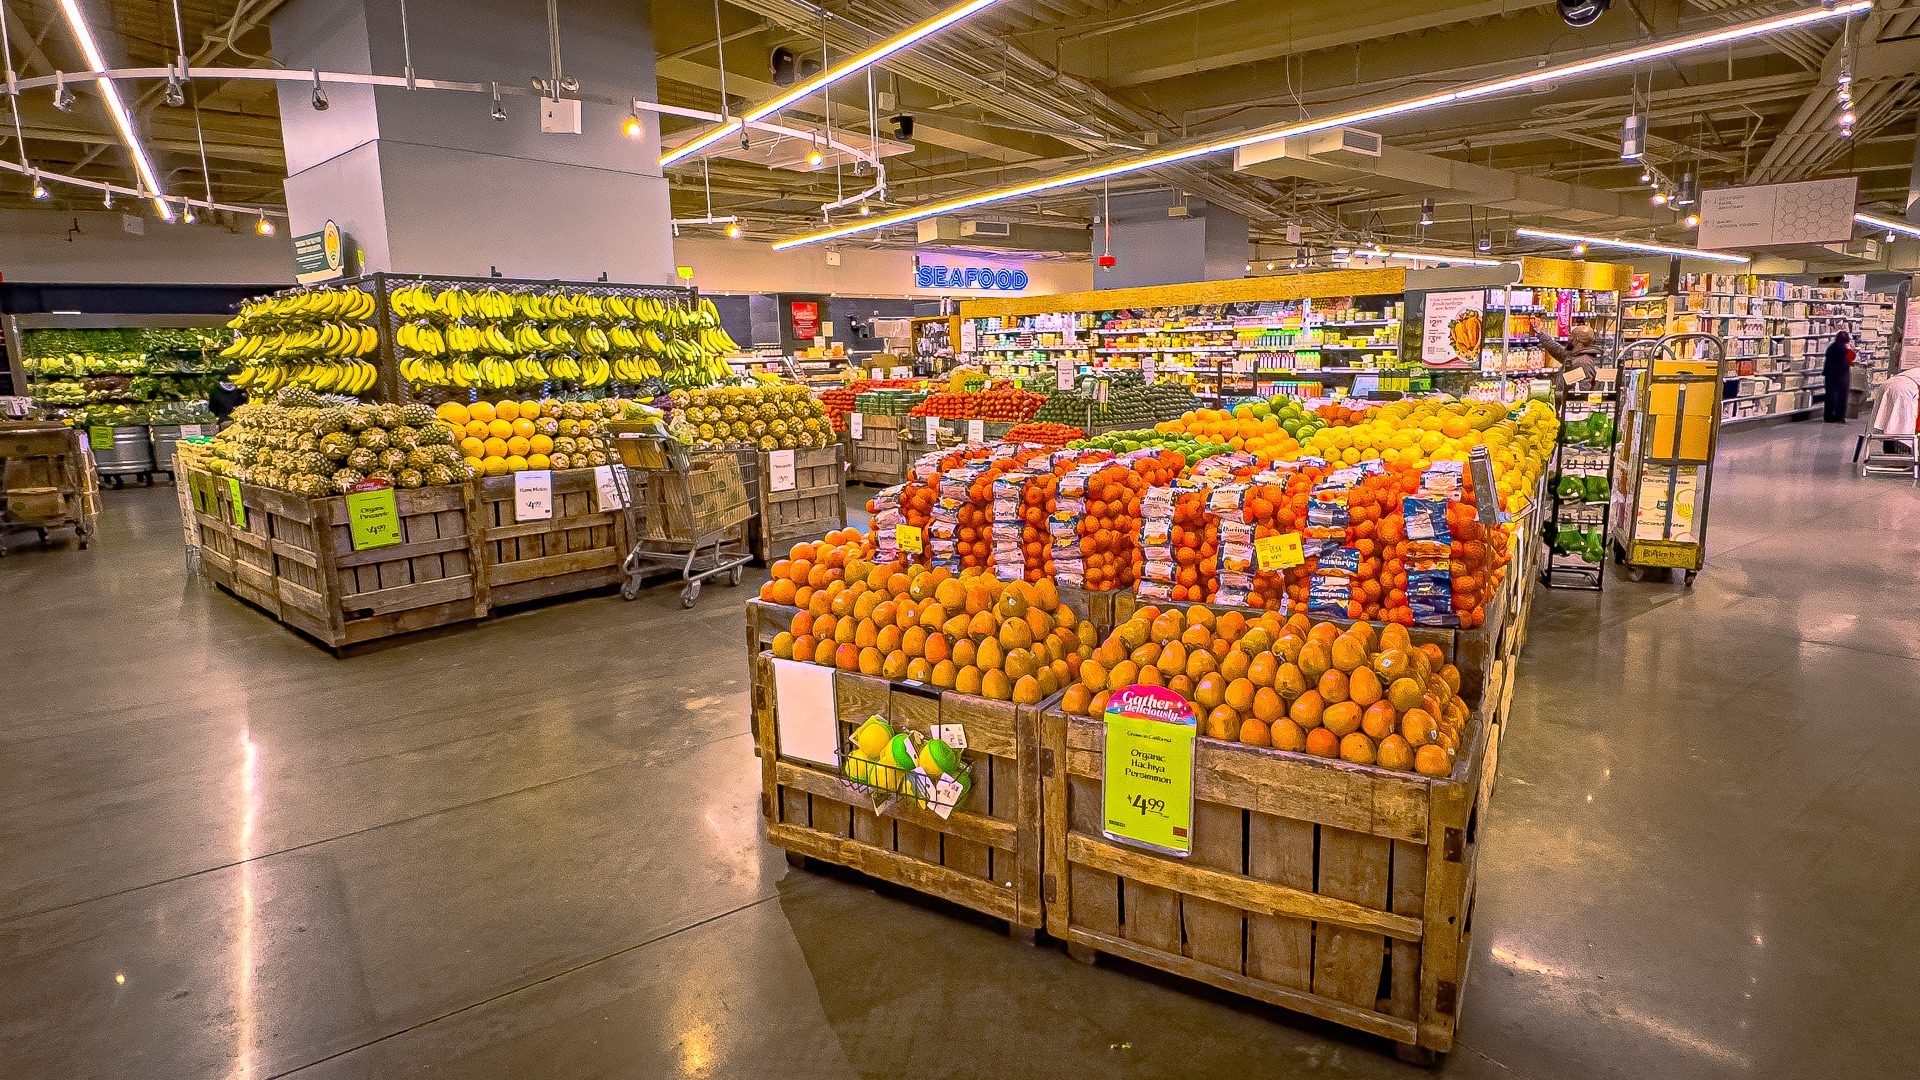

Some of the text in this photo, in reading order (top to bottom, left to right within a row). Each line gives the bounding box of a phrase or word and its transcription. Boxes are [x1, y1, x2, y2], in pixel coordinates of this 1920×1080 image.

[917, 265, 1029, 290] SEAFOOD
[1637, 519, 1665, 527] Coconut
[1121, 689, 1174, 711] Gather
[1123, 703, 1181, 722] deliciously
[1148, 733, 1172, 743] California
[1130, 748, 1166, 763] Organic
[1131, 758, 1166, 774] Hachiya
[1124, 767, 1172, 785] Persimmon
